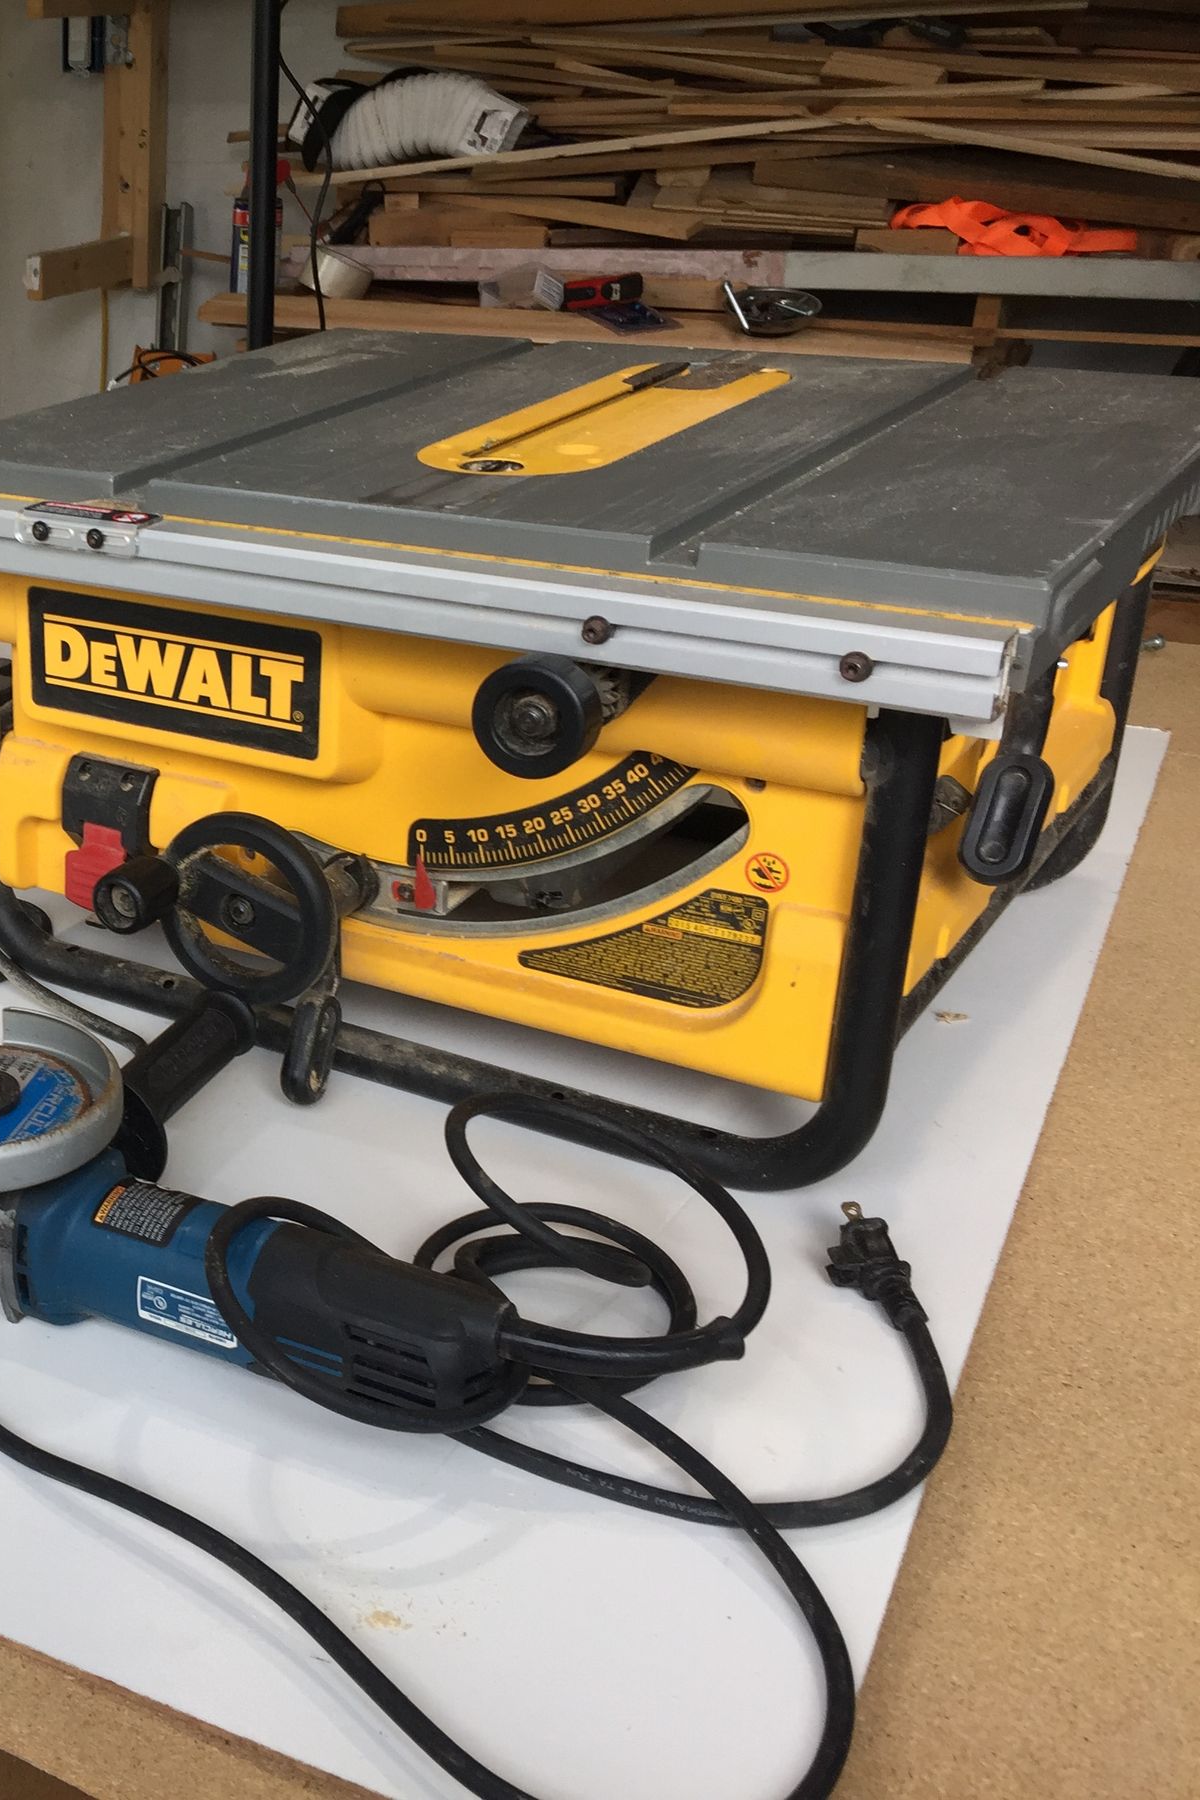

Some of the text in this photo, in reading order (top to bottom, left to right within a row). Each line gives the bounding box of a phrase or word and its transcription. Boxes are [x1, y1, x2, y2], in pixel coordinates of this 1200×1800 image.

[415, 828, 427, 842] 0
[444, 830, 456, 844] 5
[466, 828, 489, 843] 10
[495, 824, 517, 839] 15
[522, 817, 546, 834] 20
[550, 806, 574, 825] 25
[577, 793, 601, 813] 30
[602, 779, 626, 800] 35
[626, 763, 649, 785] 40
